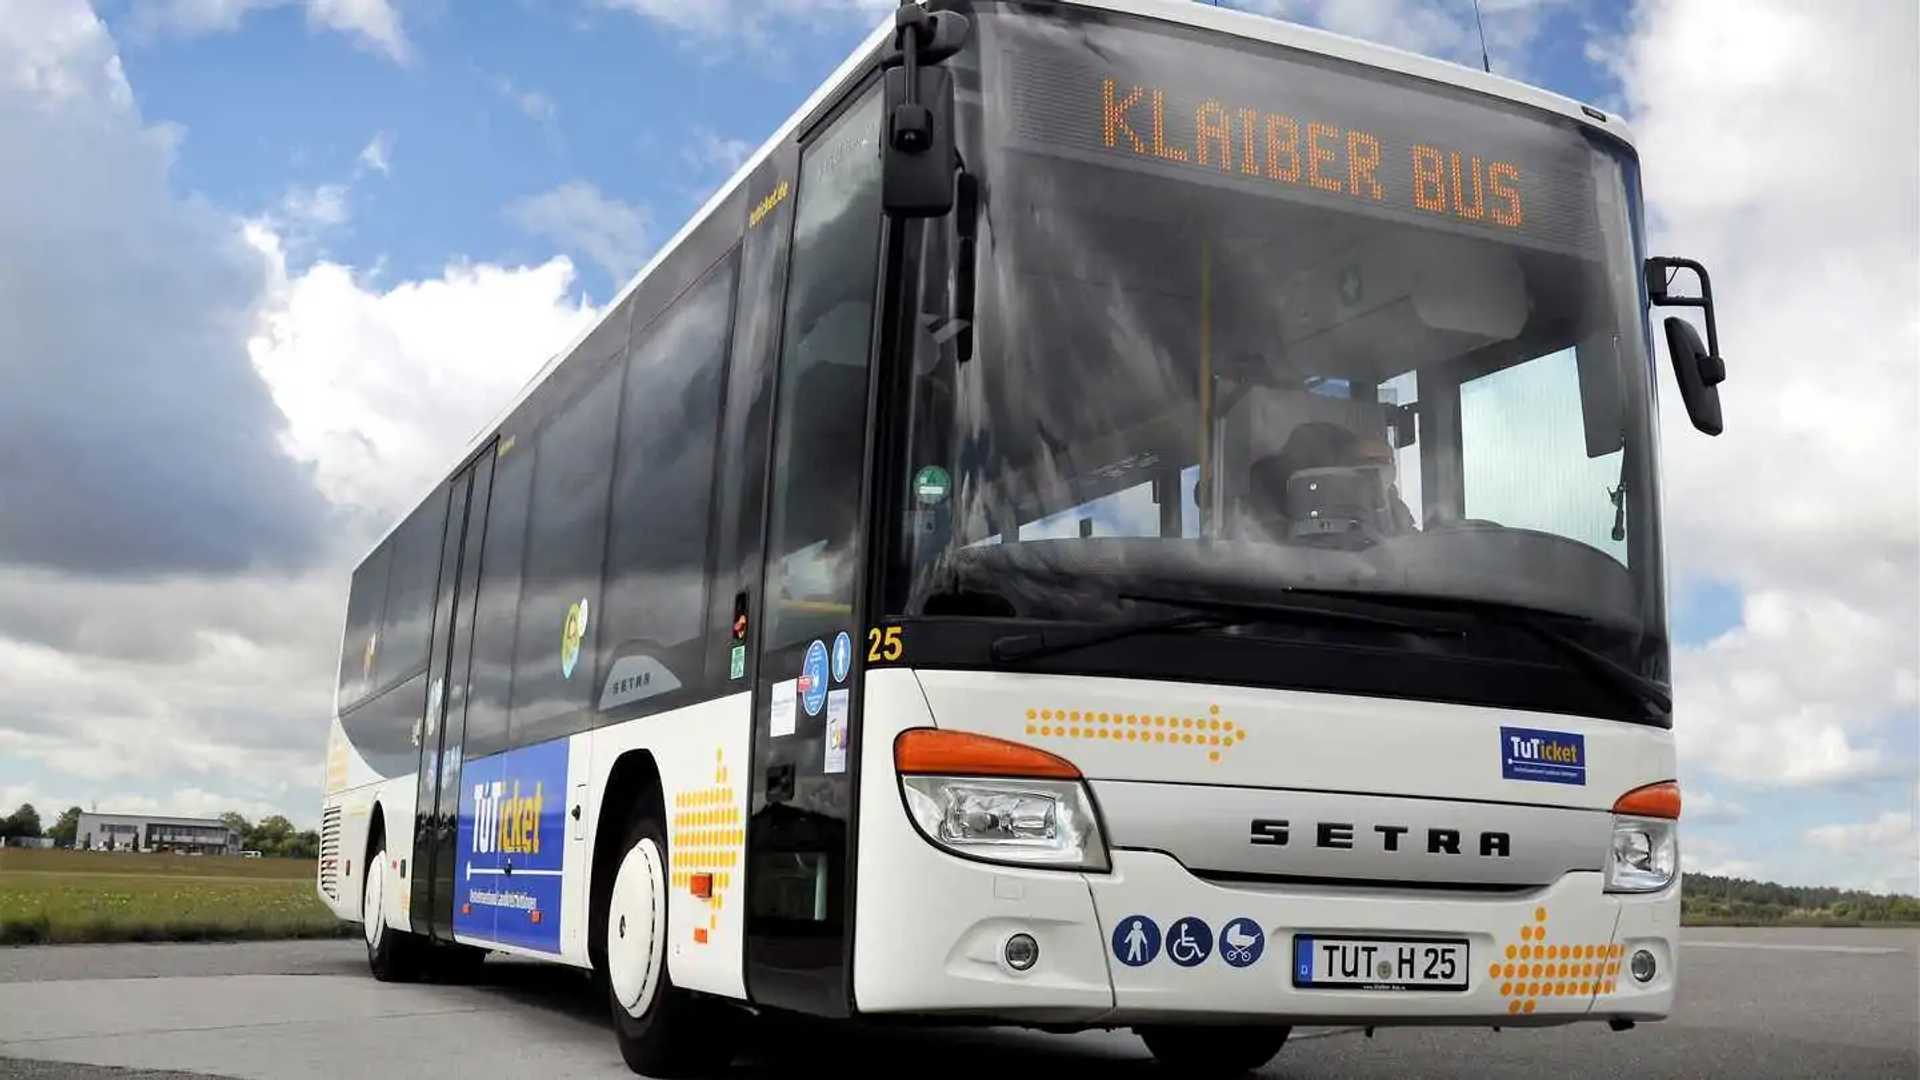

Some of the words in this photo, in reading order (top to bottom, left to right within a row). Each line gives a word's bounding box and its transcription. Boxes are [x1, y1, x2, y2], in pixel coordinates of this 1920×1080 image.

[1102, 79, 1383, 199] KLAIBER
[1412, 143, 1522, 226] BUS
[868, 626, 903, 662] 25
[1510, 736, 1577, 763] TuTicket
[1250, 818, 1511, 857] SETRA
[1323, 945, 1378, 978] TUT
[1398, 947, 1415, 978] H
[1423, 948, 1456, 979] 25
